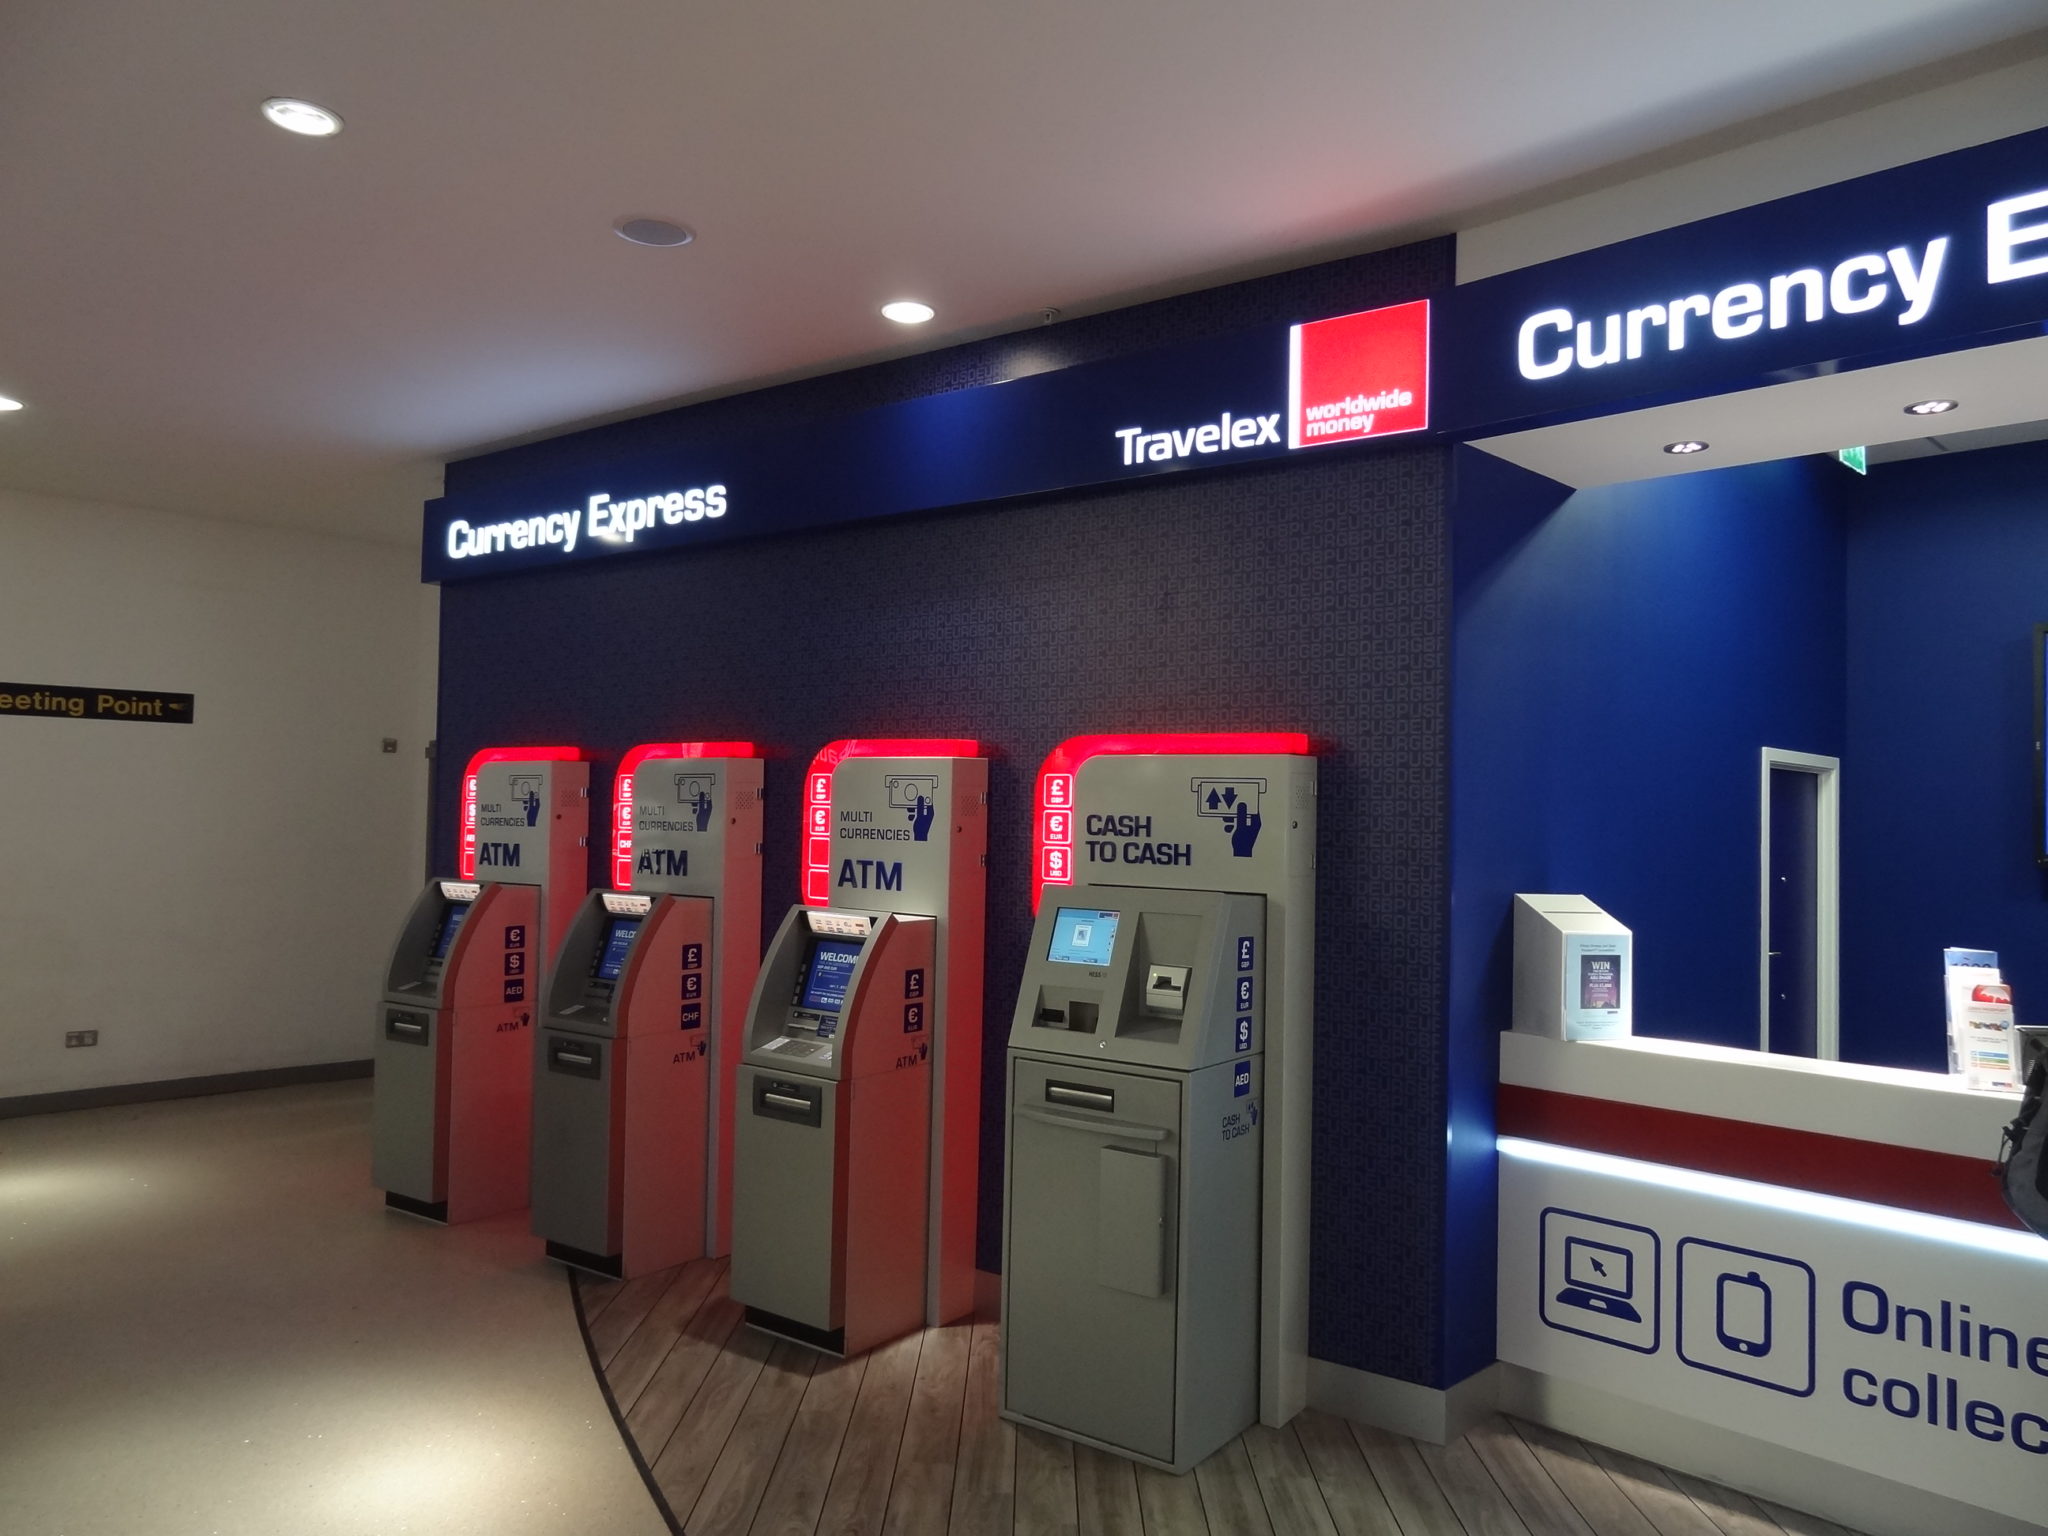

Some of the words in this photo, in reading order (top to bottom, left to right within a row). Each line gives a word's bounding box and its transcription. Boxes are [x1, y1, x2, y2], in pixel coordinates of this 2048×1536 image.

[1518, 237, 1948, 381] Currency
[1306, 388, 1412, 422] worldwide
[1306, 412, 1375, 438] money
[1115, 412, 1281, 466] Travelex
[448, 509, 581, 559] Currency
[588, 484, 727, 543] Express
[97, 694, 163, 716] Point
[1051, 779, 1064, 796] £
[481, 803, 502, 813] MULTI
[640, 806, 665, 816] MULTI
[481, 817, 525, 827] CURRENCIES
[815, 810, 826, 824] €
[840, 811, 873, 822] MULTI
[1050, 816, 1063, 832] €
[639, 820, 694, 832] CURRENCIES
[1086, 814, 1152, 838] CASH
[840, 828, 910, 841] CURRENCIES
[479, 842, 521, 867] ATM
[1049, 850, 1063, 869] $
[1085, 841, 1117, 863] TO
[1123, 842, 1192, 866] CASH
[637, 849, 689, 877] ATM
[838, 859, 903, 892] ATM
[510, 929, 520, 941] €
[687, 948, 697, 962] £
[1242, 940, 1250, 959] £
[509, 954, 520, 968] $
[820, 951, 859, 964] WELCOM
[1591, 961, 1610, 970] WIN
[687, 977, 696, 990] €
[910, 974, 919, 989] £
[506, 986, 523, 995] AED
[1241, 982, 1249, 1000] €
[683, 1011, 700, 1021] CHF
[908, 1007, 918, 1023] €
[496, 1021, 519, 1033] ATM
[1240, 1020, 1248, 1042] $
[673, 1051, 696, 1065] ATM
[896, 1054, 918, 1069] ATM
[1235, 1072, 1249, 1087] AED
[1222, 1113, 1241, 1128] CASH
[1222, 1128, 1230, 1141] TO
[1231, 1123, 1250, 1138] CASH
[1842, 1280, 2048, 1378] Online
[1843, 1367, 2048, 1455] collec
